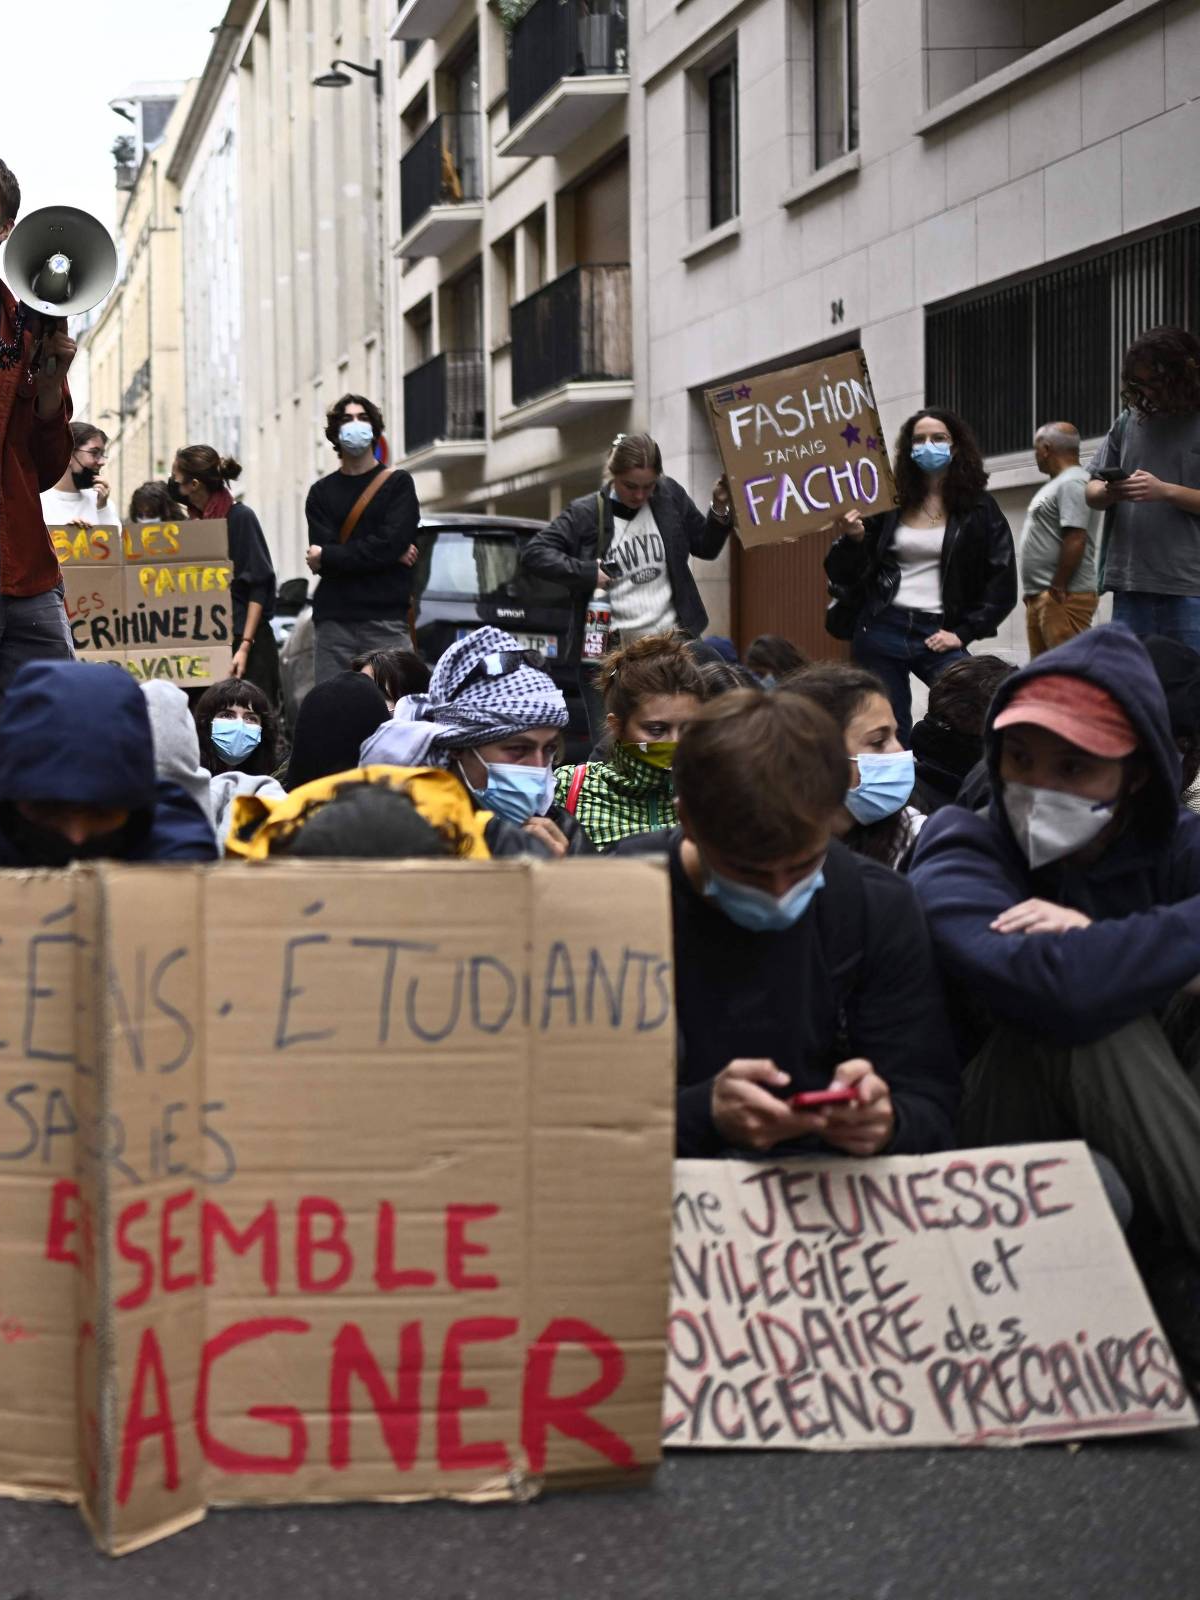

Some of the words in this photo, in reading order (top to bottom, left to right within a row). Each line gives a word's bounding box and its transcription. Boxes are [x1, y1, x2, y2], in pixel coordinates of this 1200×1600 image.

[764, 440, 827, 466] JAMAIS
[743, 457, 880, 526] FACHO
[122, 524, 182, 560] LES
[138, 566, 232, 598] PATTES
[95, 654, 211, 681] AVATE
[274, 900, 671, 1049] ÉTUDIANTS
[673, 1191, 726, 1235] ne
[741, 1158, 1074, 1239] JEUNESSE
[43, 1179, 501, 1309] ESEMBLE
[972, 1237, 1025, 1295] et
[667, 1296, 936, 1379] OLIDAIRE
[944, 1305, 1027, 1351] des
[78, 1316, 639, 1506] AGNER
